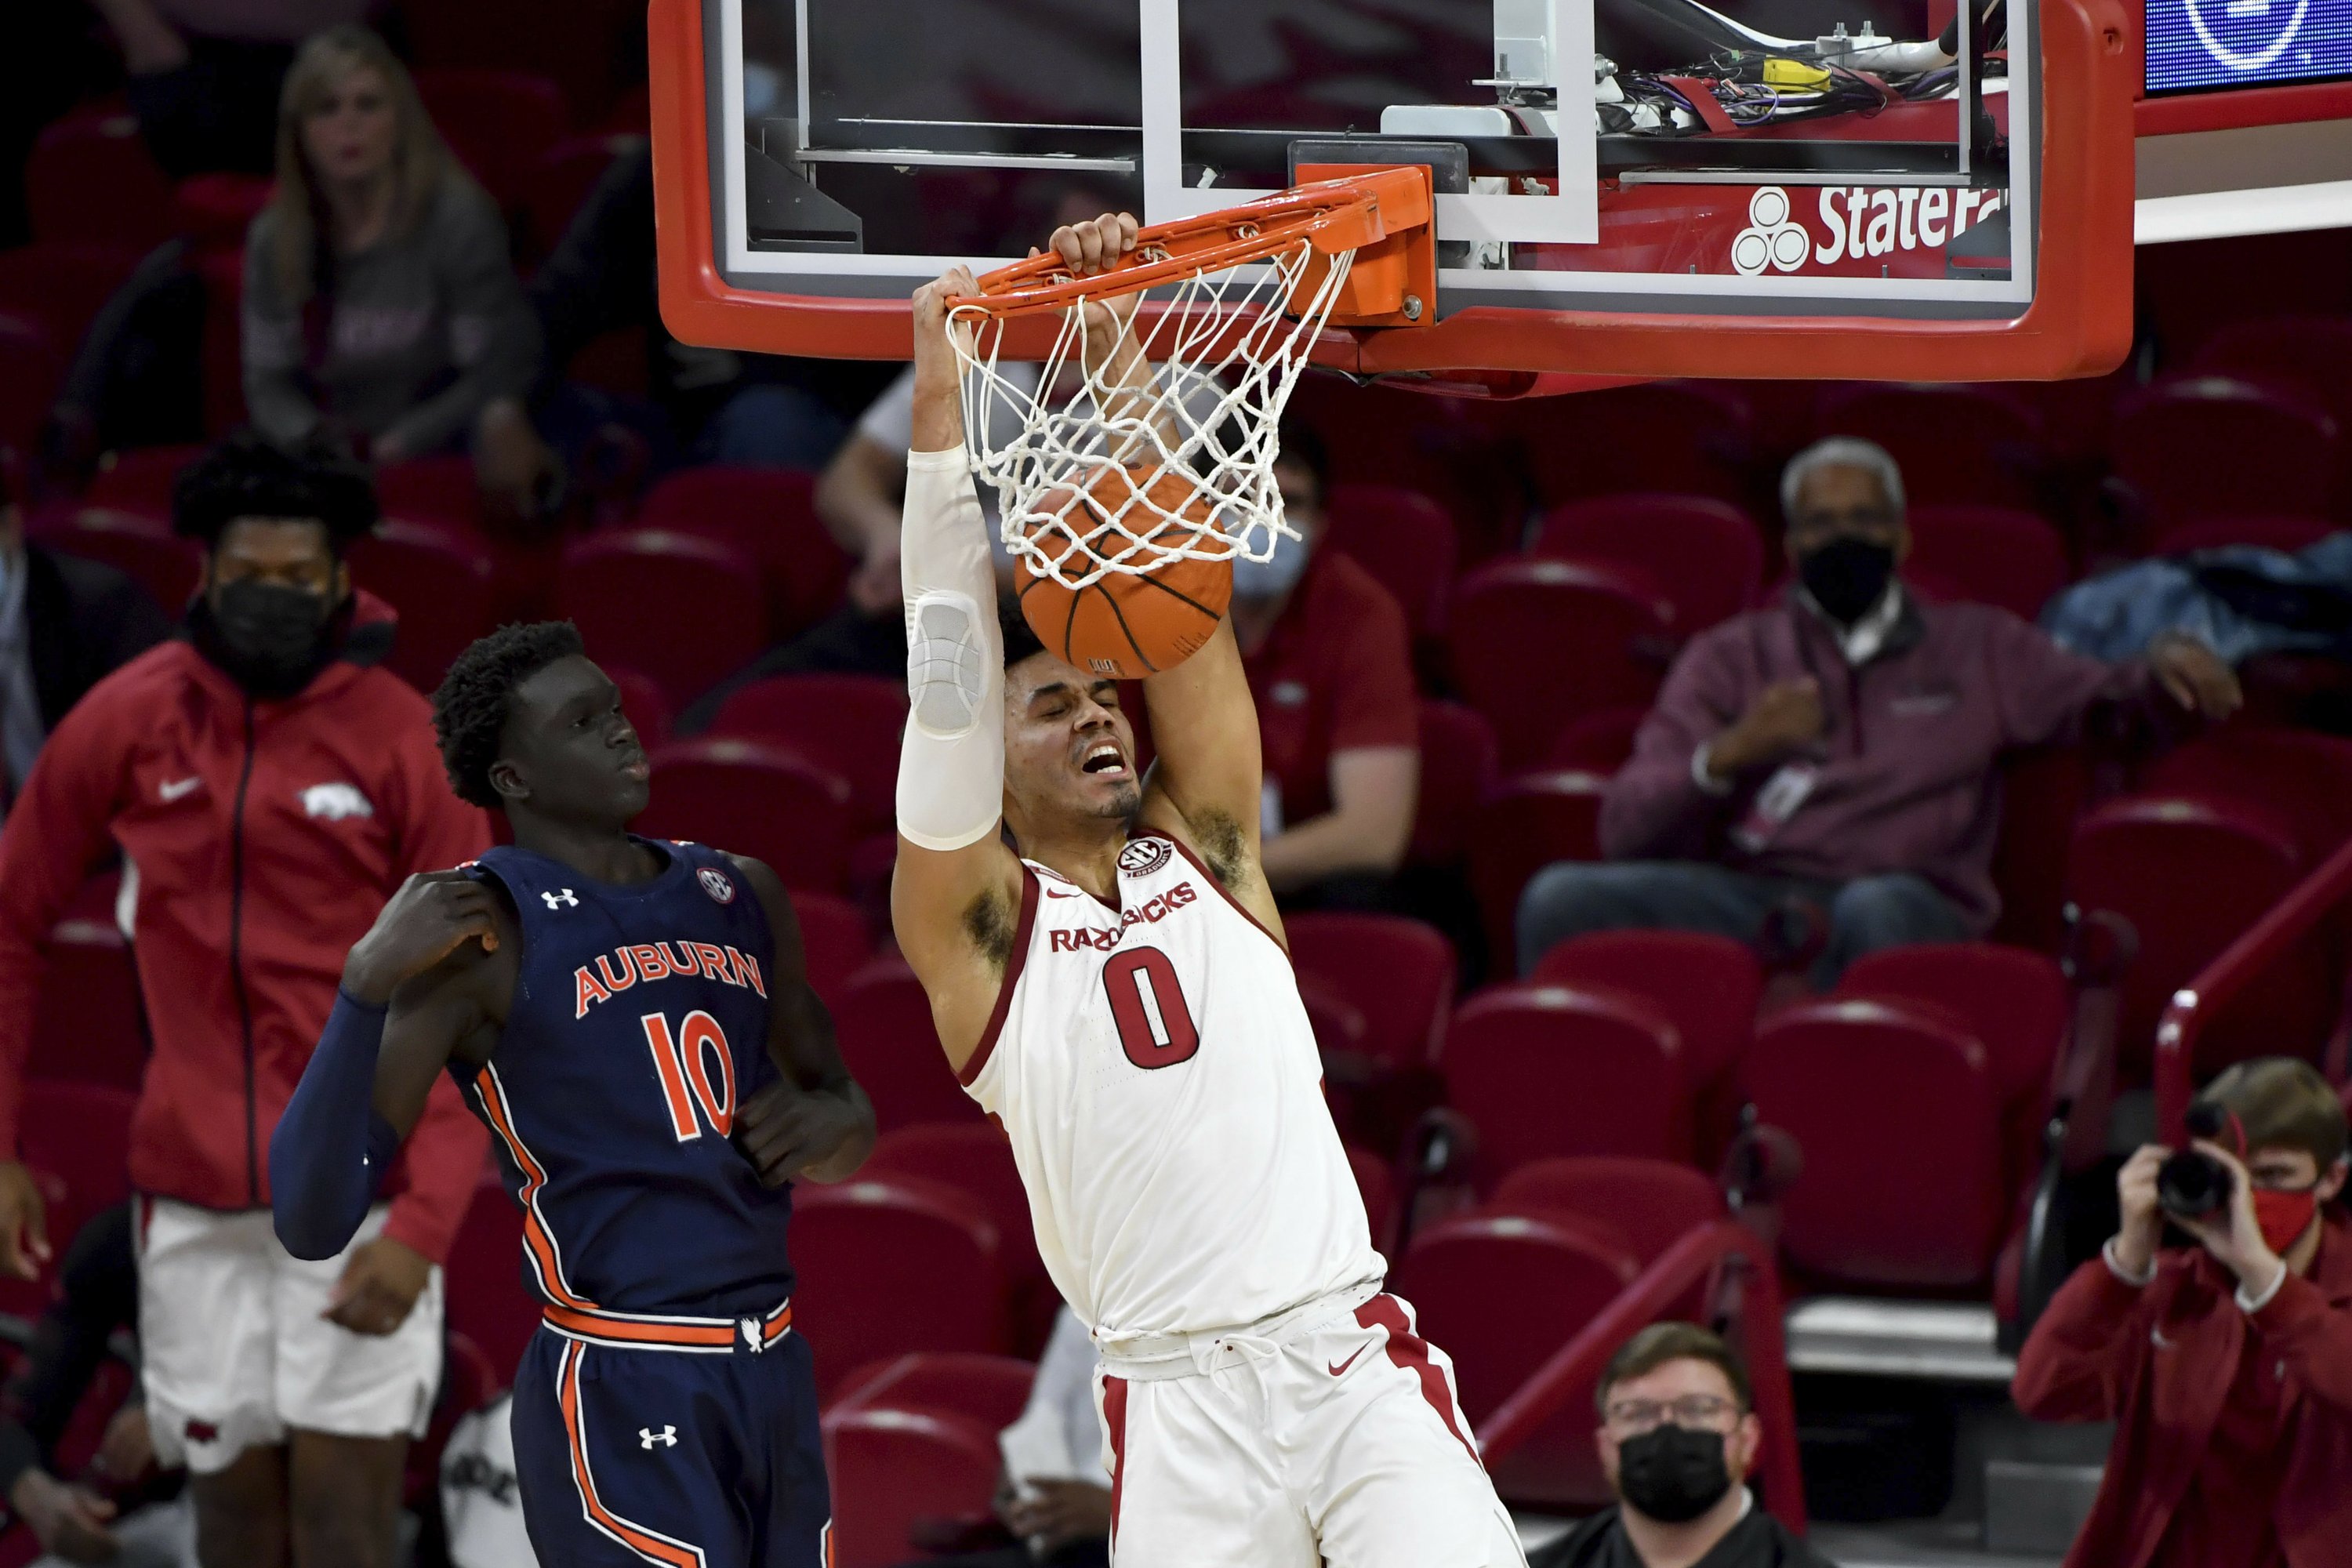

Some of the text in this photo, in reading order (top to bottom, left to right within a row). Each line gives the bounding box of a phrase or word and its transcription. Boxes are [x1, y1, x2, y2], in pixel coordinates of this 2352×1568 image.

[1815, 187, 1948, 264] State
[700, 870, 731, 901] SEC
[1120, 842, 1157, 869] SEC
[574, 941, 768, 1019] AUBURN
[1102, 946, 1200, 1069] 0
[641, 1010, 736, 1142] 10
